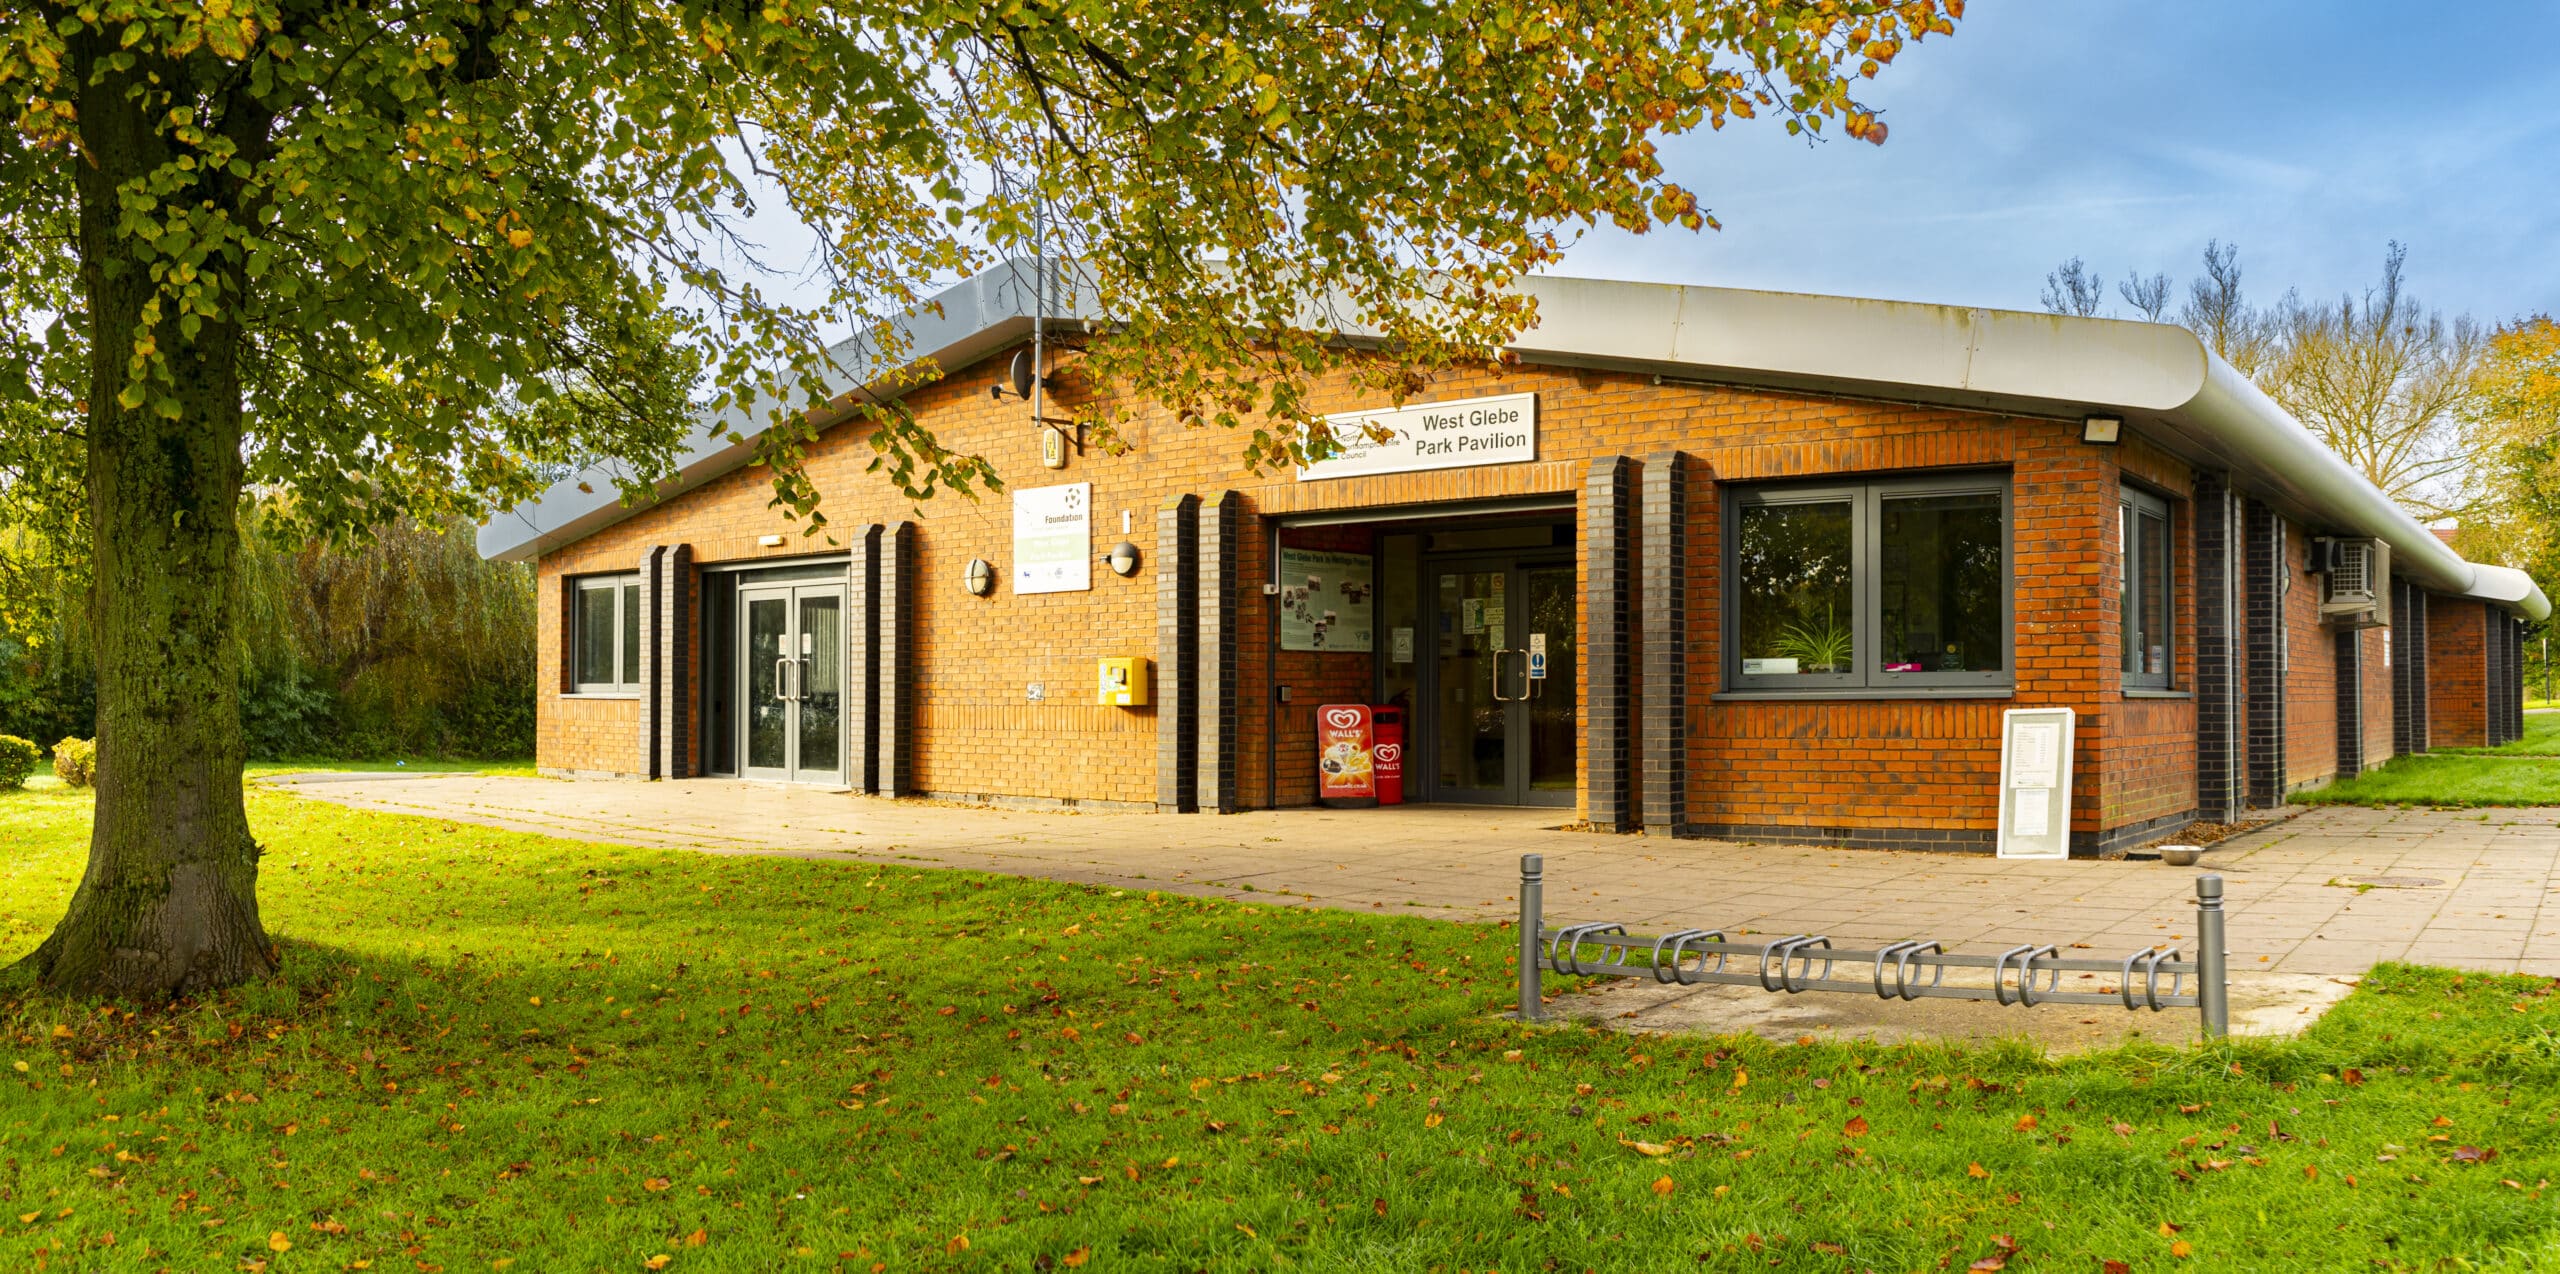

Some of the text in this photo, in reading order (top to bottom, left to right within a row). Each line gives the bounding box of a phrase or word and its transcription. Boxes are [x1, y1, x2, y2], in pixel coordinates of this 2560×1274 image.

[1423, 408, 1519, 431] West Glebe
[1341, 434, 1359, 442] North
[1416, 432, 1526, 456] Park Pavilion
[1341, 451, 1367, 460] Council
[1045, 513, 1083, 524] Foundation
[1329, 730, 1361, 738] WALL'S
